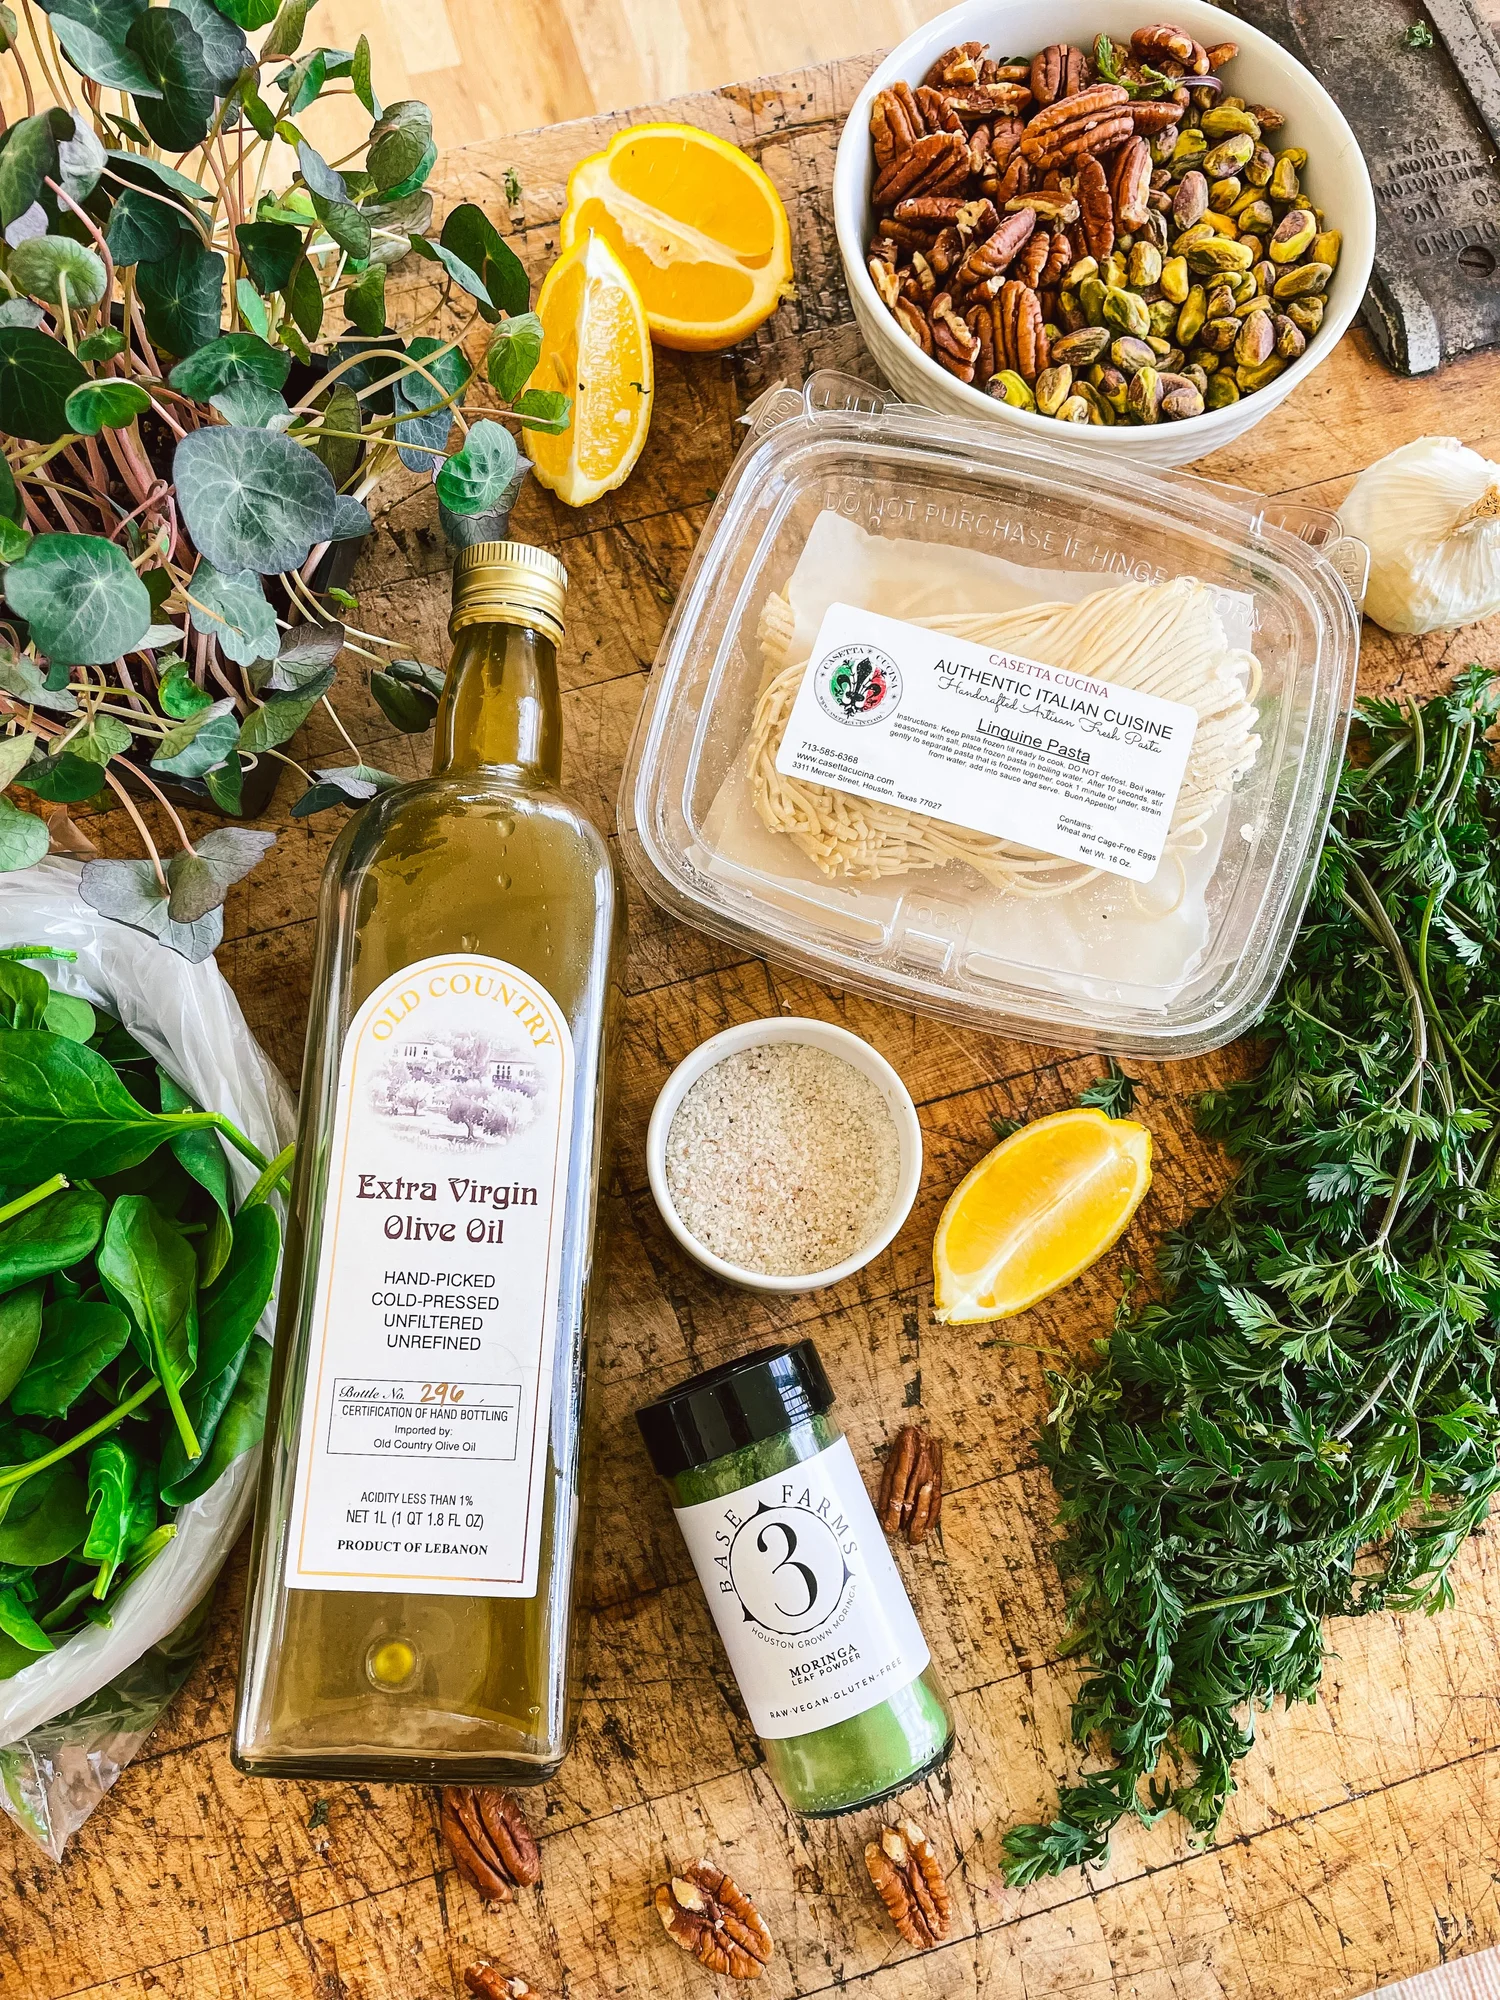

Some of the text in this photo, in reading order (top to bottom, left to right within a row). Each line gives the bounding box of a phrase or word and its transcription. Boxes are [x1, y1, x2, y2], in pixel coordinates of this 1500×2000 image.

[1387, 148, 1474, 179] VERMONT
[1402, 137, 1440, 155] USA
[762, 392, 799, 429] HOLD
[824, 490, 861, 515] DO
[868, 493, 920, 521] NOT
[925, 503, 1057, 552] PURCHASE
[1063, 534, 1086, 559] IF
[1090, 545, 1169, 587] HINGE
[823, 647, 898, 690] CASETTA CUCINA
[989, 654, 1108, 699] CASETTA CUCINA
[933, 659, 1174, 741] AUTHENTIC ITALIAN CUISINE
[937, 676, 1162, 754] Handcrafted Artisan Fresh Pasta
[801, 741, 859, 765] 713-585-6368
[975, 718, 1091, 763] Linguine Pasta
[796, 752, 895, 786] www.casettacucina.com
[889, 730, 912, 742] gently
[912, 736, 921, 744] to
[921, 739, 953, 753] separate
[953, 749, 974, 760] pasta
[975, 755, 990, 764] that
[998, 761, 1022, 773] frozen
[1055, 779, 1073, 789] cook
[1081, 787, 1106, 799] minute
[1140, 805, 1162, 817] strain
[893, 722, 929, 737] seasoned
[929, 732, 945, 743] with
[961, 742, 982, 753] place
[983, 747, 1006, 759] frozen
[1006, 755, 1028, 766] pasta
[1028, 760, 1037, 769] in
[1036, 764, 1061, 778] boiling
[1086, 778, 1105, 789] After
[1107, 784, 1117, 793] 10
[1151, 799, 1164, 807] stir
[940, 725, 960, 737] Keep
[960, 732, 982, 743] pasta
[982, 737, 1005, 750] frozen
[1015, 749, 1037, 761] ready
[1038, 754, 1046, 762] to
[1067, 763, 1081, 772] DO
[1081, 767, 1100, 778] NOT
[1129, 781, 1144, 792] Boil
[1145, 788, 1166, 798] water
[792, 761, 943, 810] 3311 Mercer Street, Houston, Texas 77027
[928, 749, 945, 760] from
[968, 763, 984, 772] add
[984, 768, 998, 776] into
[999, 772, 1022, 783] sauce
[1022, 779, 1038, 788] and
[1064, 790, 1084, 802] Buon
[1084, 797, 1118, 811] Appetito!
[1059, 814, 1095, 831] Contains:
[1056, 823, 1157, 862] Wheat and Cage-Free Eggs
[1079, 845, 1093, 856] Net
[1109, 855, 1118, 864] 16
[905, 903, 963, 934] LOCK
[371, 973, 555, 1049] OLD COUNTRY
[356, 1174, 539, 1210] Extra Virgin
[383, 1215, 504, 1244] Olive Oil
[384, 1270, 496, 1289] HAND-PICKED
[371, 1292, 500, 1311] COLD-PRESSED
[384, 1314, 484, 1331] UNFILTERED
[386, 1333, 481, 1351] UNREFINED
[338, 1382, 465, 1407] Bottle No. 296
[342, 1404, 508, 1422] CERTIFICATION OF HAND BOTTLING
[394, 1424, 453, 1437] Imported by:
[373, 1438, 476, 1452] Old Country Olive Oil
[360, 1491, 474, 1506] ACIDITY LESS THAN 1%
[346, 1509, 484, 1531] NET 1L (1 QT 1.8 FL OZ)
[337, 1539, 489, 1556] PRODUCT OF LEBANON
[713, 1484, 858, 1594] BASE FARMS
[756, 1522, 818, 1617] 3
[751, 1584, 857, 1649] HOUSTON GROWN MORINGA
[788, 1643, 858, 1679] MORINGA
[791, 1652, 861, 1687] LEAF POWDER
